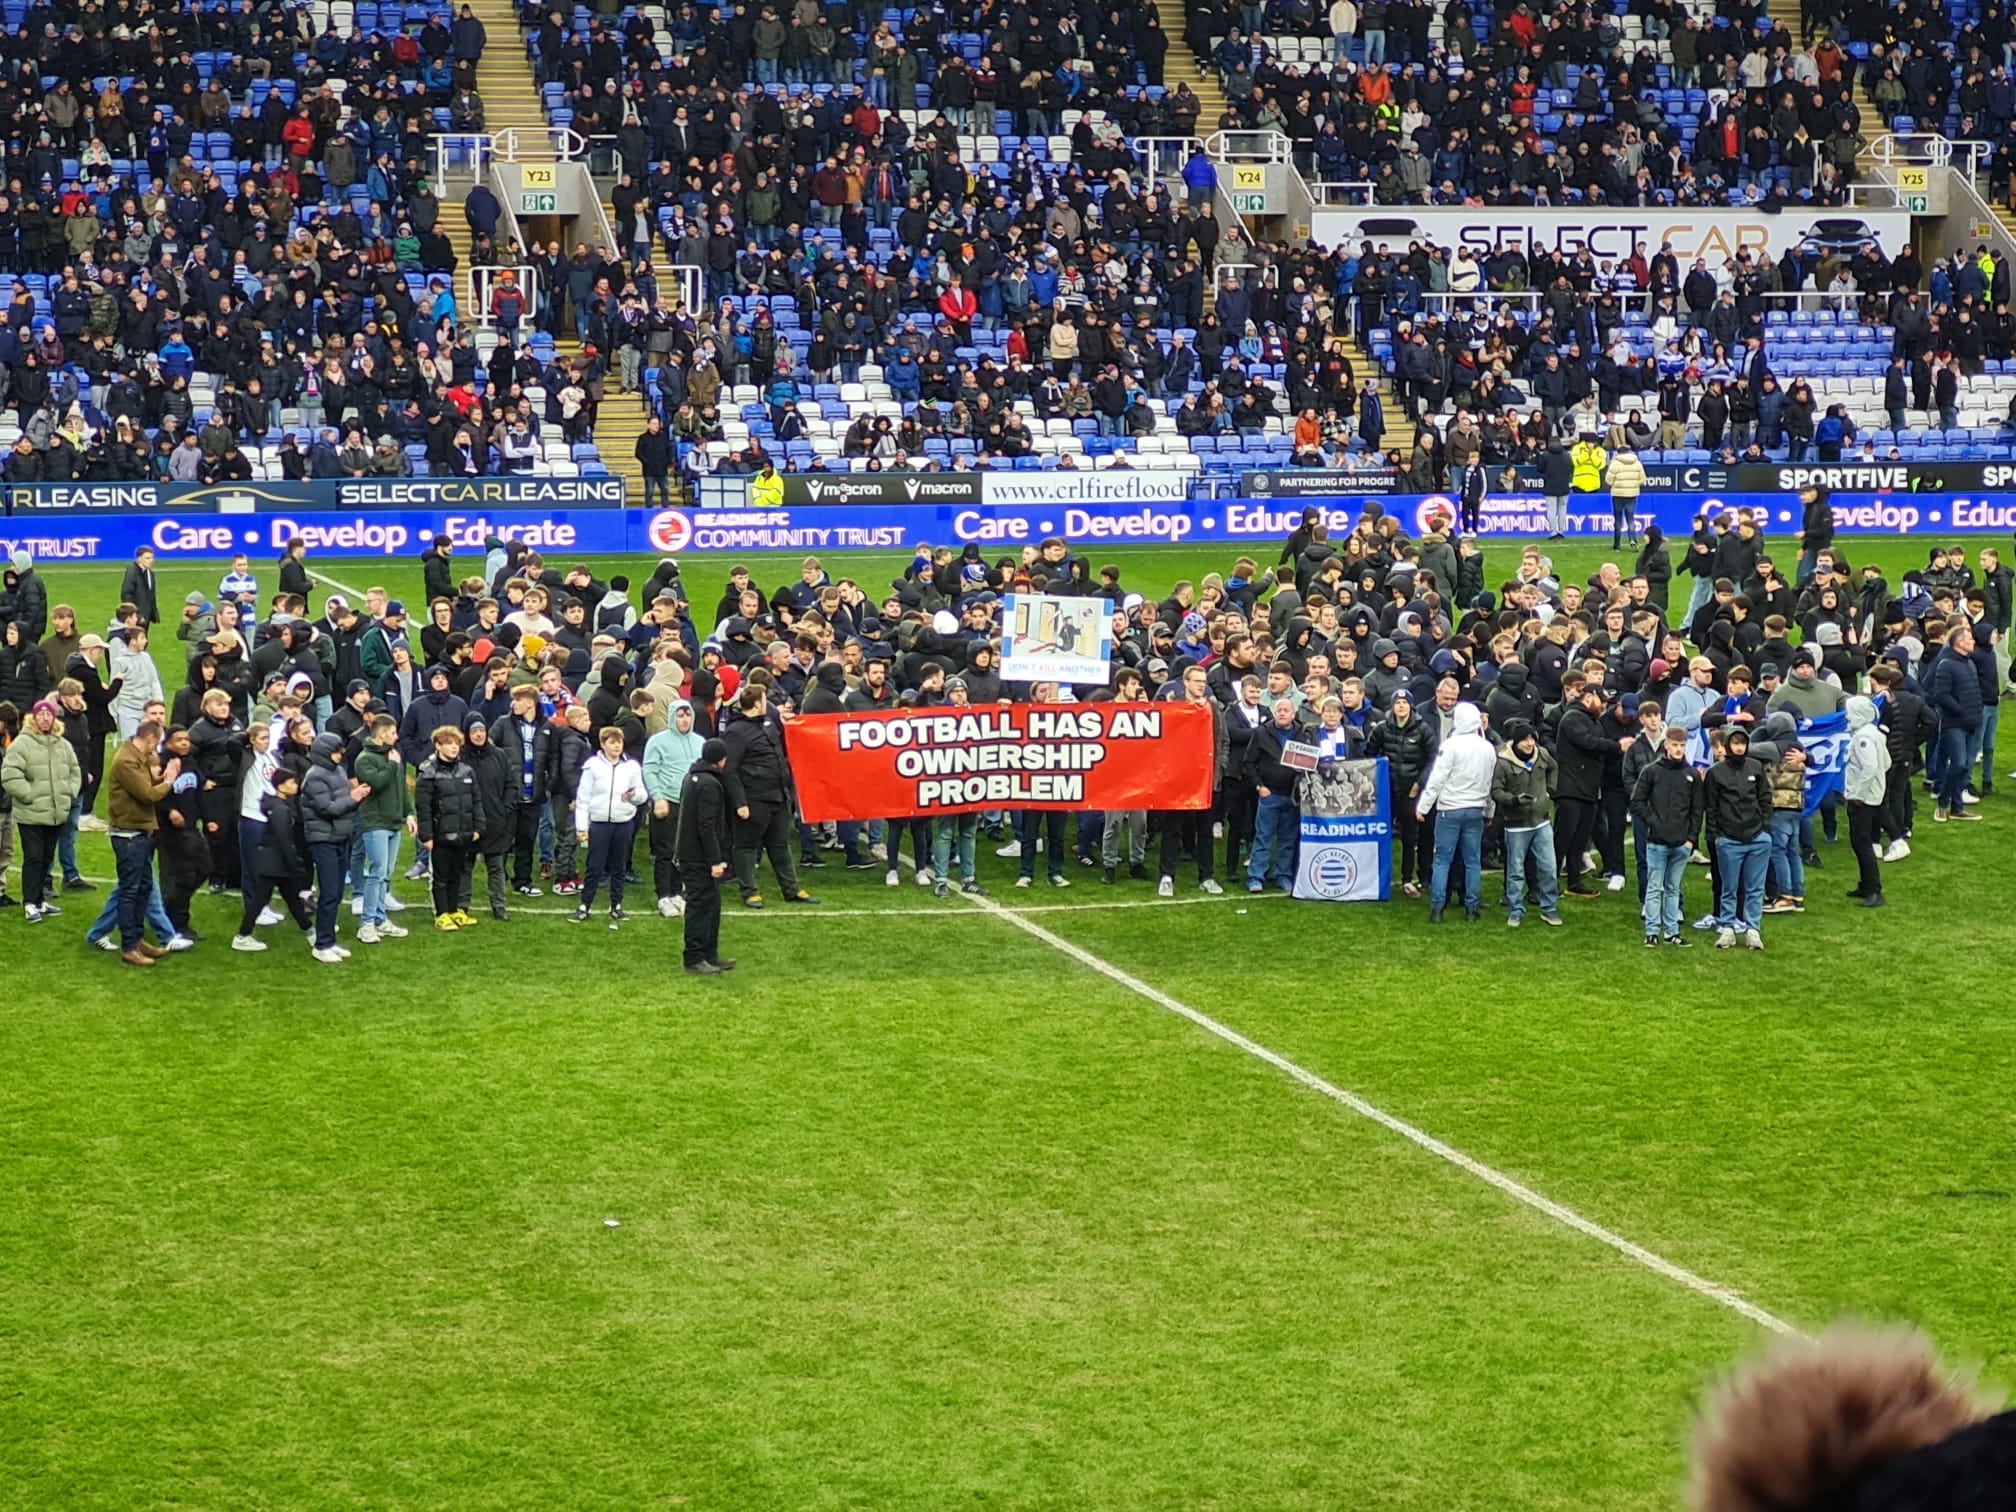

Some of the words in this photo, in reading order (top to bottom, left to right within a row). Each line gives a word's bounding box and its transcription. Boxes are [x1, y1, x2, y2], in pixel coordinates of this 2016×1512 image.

[527, 170, 551, 182] Y23
[1238, 172, 1260, 183] Y24
[1903, 174, 1924, 185] Y25
[1661, 225, 1769, 258] CAR
[921, 483, 972, 495] macron
[991, 476, 1185, 500] www.crlfireflood
[1280, 477, 1338, 487] PARTNERING
[1339, 477, 1357, 487] FOR
[1778, 467, 1909, 490] SPORTFIVE
[0, 487, 157, 508] RLEASING
[953, 510, 1029, 539] Care
[1064, 508, 1191, 542] Develop
[1226, 503, 1349, 533] Educte
[1588, 513, 1656, 532] TRST
[1831, 500, 1920, 534] evelop
[152, 520, 232, 549] Care
[271, 518, 407, 553] Develop
[694, 527, 831, 548] COMMUNITY
[833, 526, 906, 547] TRUST
[22, 537, 102, 557] TRUST
[1039, 664, 1056, 674] KILL
[837, 711, 1022, 750] FOOTBALL
[1028, 710, 1103, 742] HAS
[1108, 709, 1162, 740] AN
[895, 741, 1106, 778] OWNERSHIP
[917, 774, 1084, 808] PROBLEM
[1301, 823, 1366, 837] READING
[1367, 822, 1388, 835] FC
